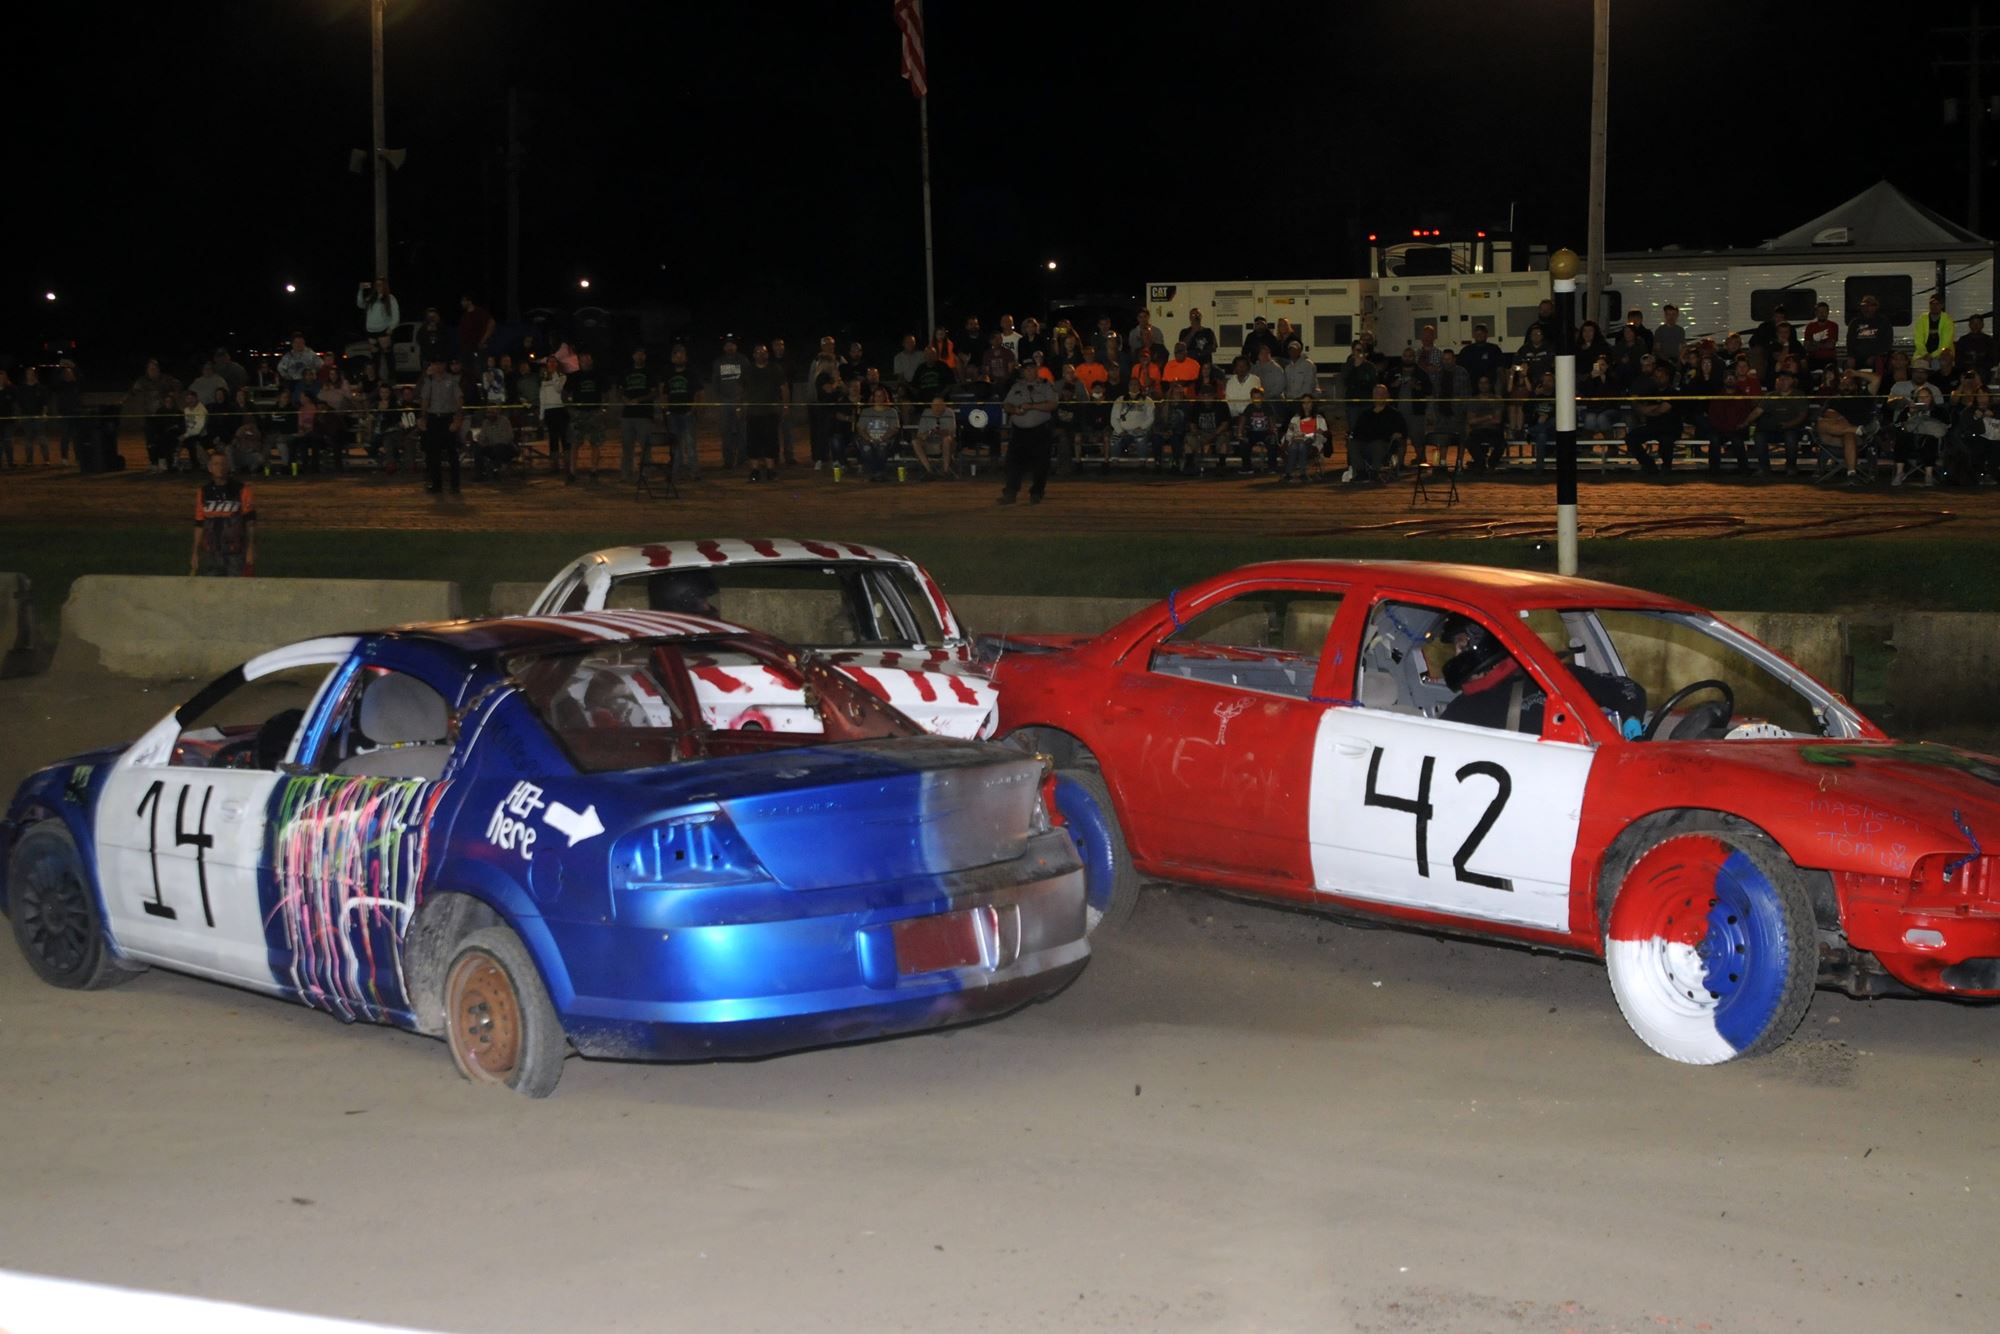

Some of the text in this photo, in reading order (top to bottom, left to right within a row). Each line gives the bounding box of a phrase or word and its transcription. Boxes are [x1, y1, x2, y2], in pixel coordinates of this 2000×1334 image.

[1152, 286, 1168, 298] CAT
[136, 780, 214, 928] 14
[1364, 746, 1514, 893] 42
